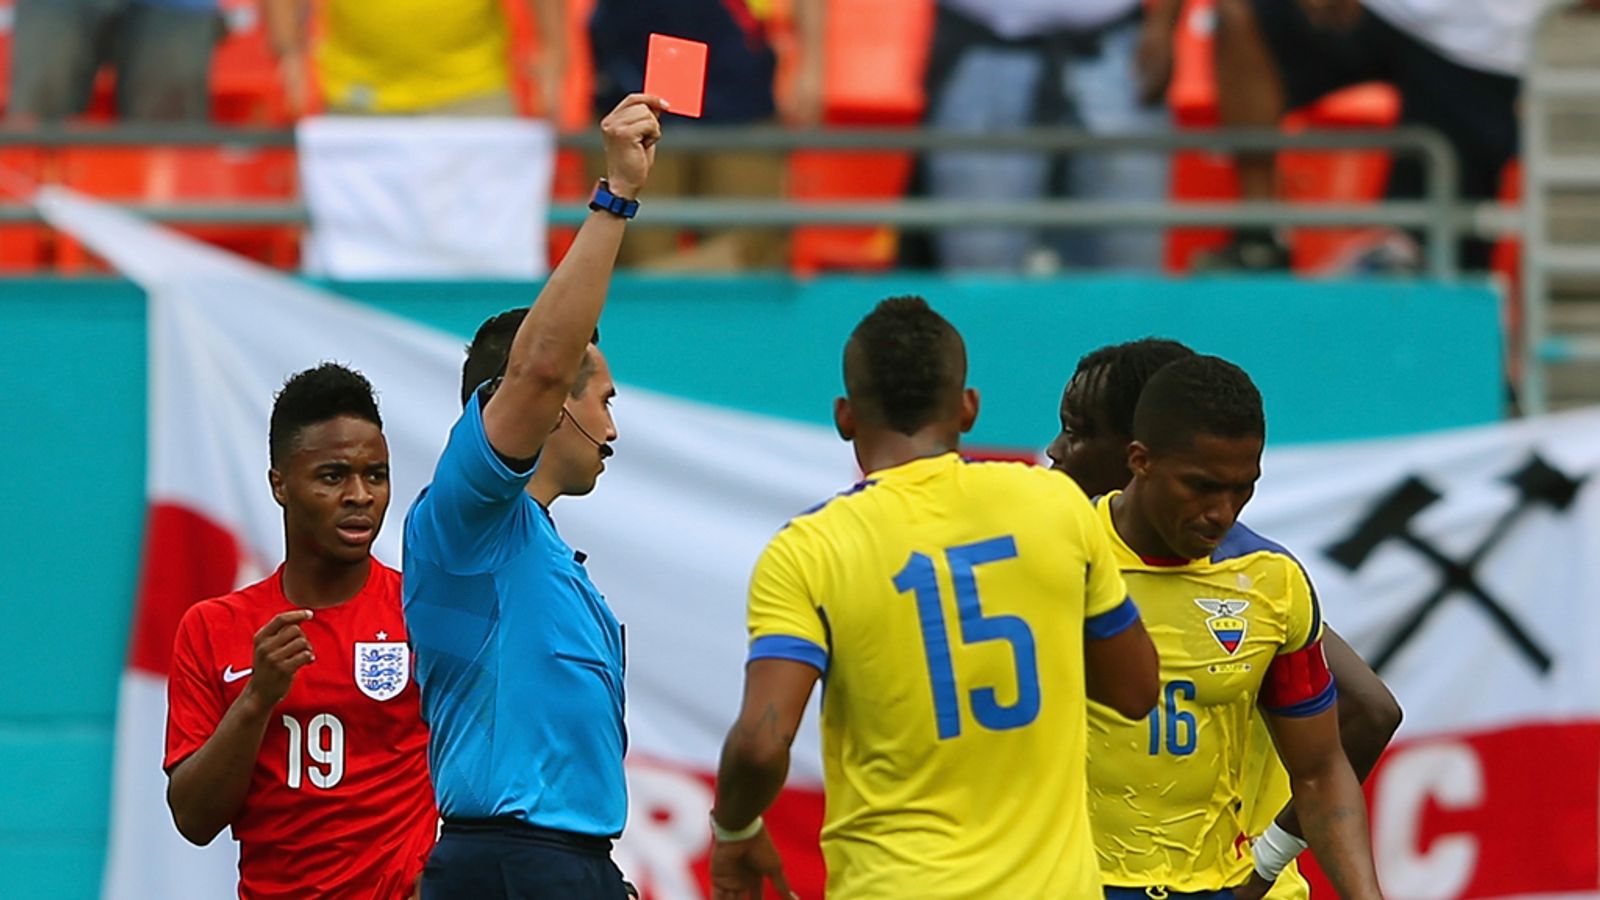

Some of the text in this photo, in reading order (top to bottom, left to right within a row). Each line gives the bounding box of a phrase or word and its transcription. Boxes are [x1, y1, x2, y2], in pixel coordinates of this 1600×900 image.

[891, 534, 1042, 740] 15
[282, 713, 344, 789] 19
[1147, 680, 1197, 756] 16
[626, 768, 714, 900] R
[1373, 740, 1485, 900] C
